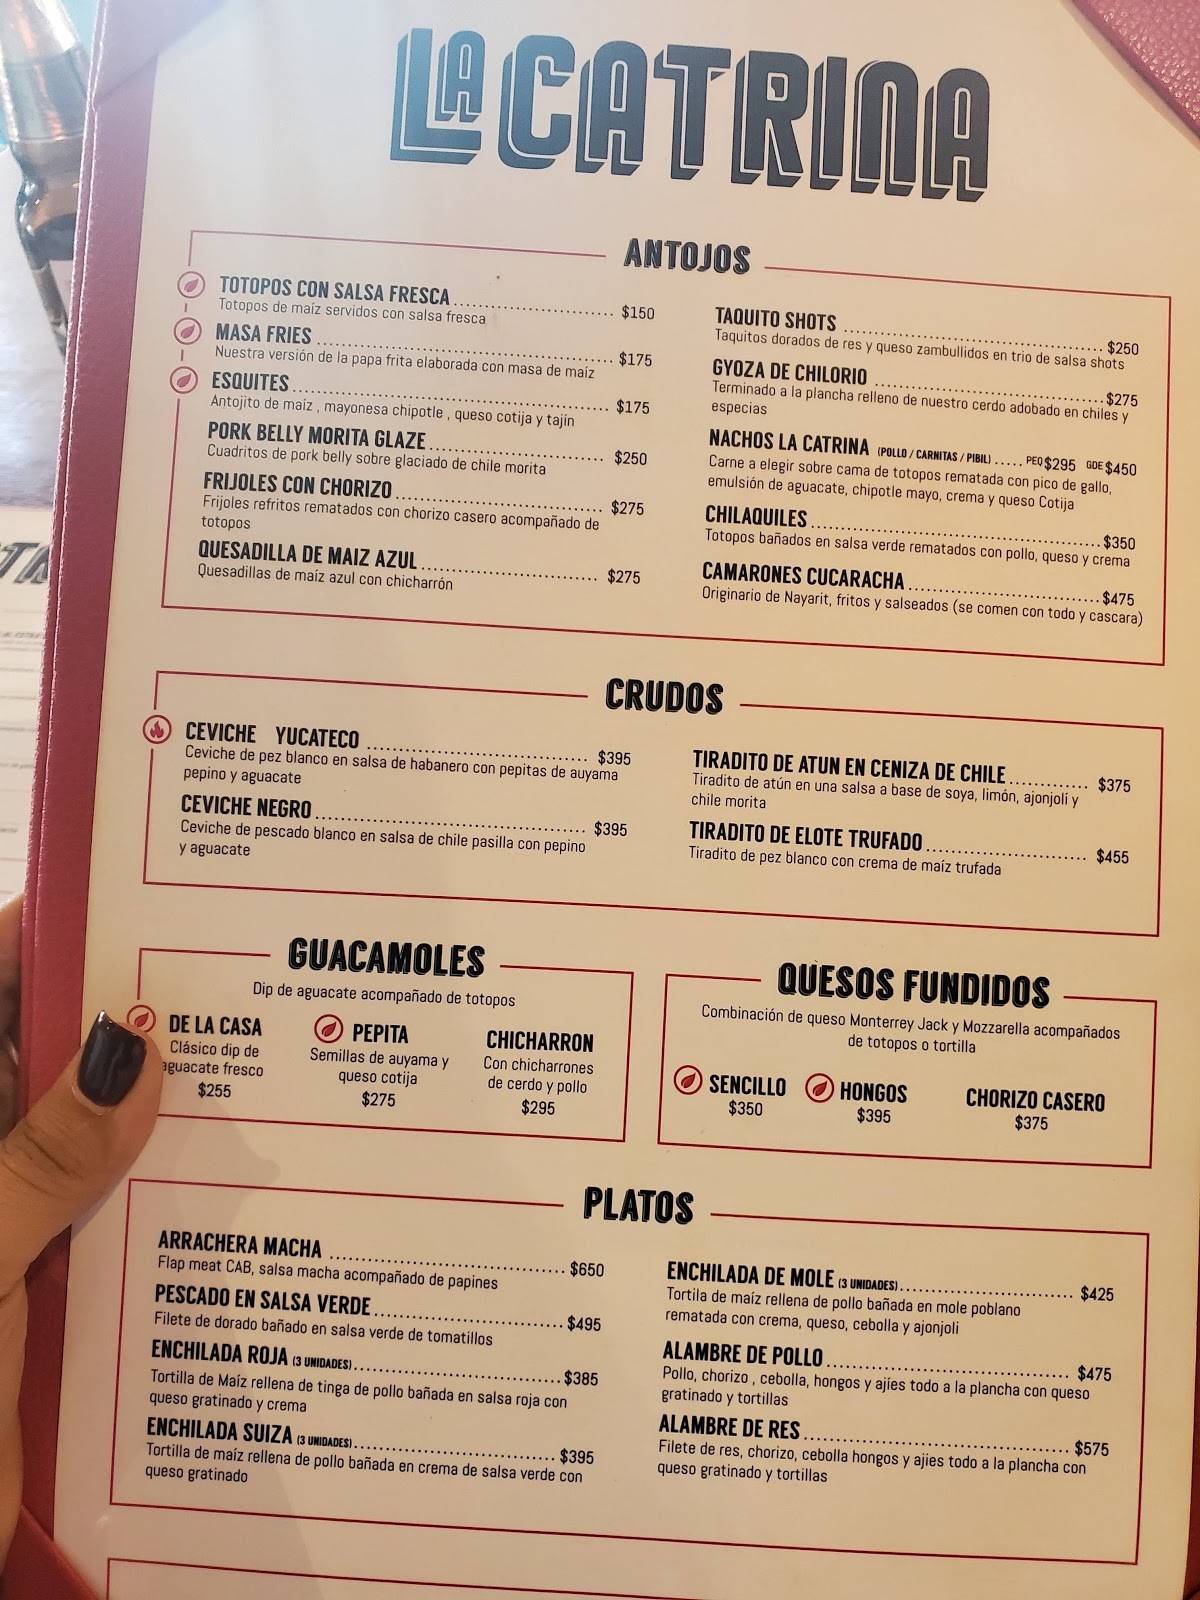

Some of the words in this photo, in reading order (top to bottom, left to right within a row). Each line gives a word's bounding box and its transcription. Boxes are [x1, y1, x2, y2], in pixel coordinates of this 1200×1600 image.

[390, 28, 486, 165] LA
[497, 34, 990, 202] CATRINA
[624, 238, 751, 275] ANTOJOS
[219, 297, 268, 314] Totopos
[273, 300, 287, 313] de
[292, 302, 321, 315] maíz
[325, 305, 378, 318] servidos
[382, 309, 404, 319] con
[409, 309, 442, 322] salsa
[446, 310, 486, 324] fresca
[220, 276, 292, 296] TOTOPOS
[297, 280, 329, 299] CON
[334, 282, 384, 302] SALSA
[389, 285, 450, 306] FRESCA
[622, 304, 655, 320] $150
[715, 306, 780, 328] TAQUITO
[785, 311, 836, 332] SHOTS
[1107, 340, 1139, 356] $250
[212, 371, 289, 392] ESQUITES
[616, 398, 650, 415] $175
[712, 402, 767, 416] especias
[208, 421, 251, 441] PORK
[256, 423, 304, 443] BELLY
[308, 426, 369, 447] MORITA
[374, 430, 426, 450] GLAZE
[614, 450, 647, 466] $250
[709, 428, 774, 450] NACHOS
[779, 433, 798, 451] LA
[803, 434, 870, 456] CATRINA
[877, 446, 907, 458] (POLLO
[916, 449, 958, 462] CARNITAS
[966, 453, 991, 464] PIBIL)
[208, 443, 268, 459] Cuadritos
[272, 447, 287, 460] de
[291, 448, 318, 463] pork
[323, 449, 352, 466] belly
[356, 452, 391, 465] sobre
[395, 454, 448, 469] glaciado
[452, 457, 467, 470] de
[471, 458, 501, 472] chile
[505, 462, 546, 475] morita
[708, 475, 764, 490] emulsión
[768, 477, 783, 491] de
[787, 481, 848, 496] aguacate,
[852, 483, 902, 499] chipotle
[906, 489, 942, 503] mayo,
[946, 492, 984, 503] crema
[988, 495, 995, 507] y
[998, 495, 1035, 508] queso
[1039, 495, 1074, 512] Cotija
[201, 516, 251, 531] totopos
[705, 504, 807, 528] CHILAQUILES
[1103, 534, 1136, 550] $350
[702, 561, 802, 584] CAMARONES
[807, 567, 905, 590] CUCARACHA
[1102, 590, 1134, 606] $475
[605, 678, 724, 715] CRUDOS
[186, 721, 257, 744] CEVICHE
[276, 726, 359, 749] YUCATECO
[598, 749, 631, 766] $395
[184, 768, 226, 782] pepino
[230, 771, 237, 784] y
[241, 771, 301, 785] aguacate
[693, 749, 768, 771] TIRADITO
[773, 754, 794, 773] DE
[798, 755, 840, 775] ATUN
[845, 757, 866, 777] EN
[870, 759, 930, 780] CENIZA
[935, 762, 956, 781] DE
[960, 764, 1006, 784] CHILE
[1098, 776, 1131, 793] $375
[691, 792, 721, 807] chile
[725, 795, 766, 809] morita
[181, 794, 252, 816] CEVICHE
[257, 798, 312, 819] NEGRO
[594, 820, 627, 837] $395
[689, 845, 737, 861] Tiradito
[741, 848, 756, 862] de
[759, 852, 782, 866] pez
[786, 850, 827, 866] blanco
[831, 856, 854, 867] con
[858, 858, 898, 870] crema
[902, 857, 917, 871] de
[921, 859, 951, 873] maíz
[955, 861, 1001, 876] trufada
[288, 937, 485, 978] GUACAMOLES
[778, 962, 894, 1001] QUESOS
[903, 969, 1050, 1009] FUNDIDOS
[169, 1014, 190, 1033] DE
[195, 1015, 215, 1035] LA
[219, 1016, 262, 1036] CASA
[353, 1023, 409, 1044] PEPITA
[170, 1040, 217, 1055] Clásico
[221, 1043, 240, 1060] dip
[244, 1044, 259, 1058] de
[487, 1030, 594, 1053] CHICHARRON
[848, 1034, 863, 1048] de
[867, 1035, 917, 1053] totopos
[921, 1041, 929, 1051] o
[933, 1039, 976, 1053] tortilla
[223, 1062, 263, 1077] fresco
[338, 1071, 377, 1084] queso
[381, 1071, 417, 1088] cotija
[484, 1055, 508, 1070] Con
[511, 1058, 594, 1075] chicharrones
[198, 1081, 231, 1098] $255
[361, 1090, 396, 1108] $275
[488, 1075, 503, 1089] de
[507, 1077, 543, 1091] cerdo
[546, 1081, 554, 1095] y
[557, 1079, 587, 1095] pollo
[709, 1074, 786, 1097] SENCILLO
[840, 1081, 908, 1104] HONGOS
[521, 1098, 555, 1116] $295
[728, 1099, 763, 1117] $350
[966, 1088, 1038, 1110] CHORIZO
[1043, 1091, 1105, 1112] CASERO
[857, 1106, 891, 1124] $395
[1015, 1114, 1048, 1131] $375
[583, 1187, 695, 1225] PLATOS
[158, 1230, 258, 1255] ARRACHERA
[263, 1236, 322, 1259] MACHA
[570, 1260, 604, 1278] $650
[667, 1261, 759, 1285] ENCHILADA
[764, 1266, 786, 1286] DE
[790, 1268, 835, 1288] MOLE
[1080, 1285, 1114, 1302] $425
[154, 1311, 191, 1326] Filete
[195, 1314, 210, 1328] de
[214, 1315, 257, 1331] dorado
[261, 1318, 307, 1334] bañado
[311, 1324, 327, 1335] en
[331, 1323, 365, 1338] salsa
[369, 1326, 404, 1340] verde
[408, 1328, 423, 1342] de
[427, 1330, 493, 1346] tomatillos
[151, 1339, 242, 1363] ENCHILADA
[248, 1345, 288, 1366] ROJA
[292, 1355, 302, 1367] (3
[304, 1357, 352, 1371] UNIDADES)
[564, 1369, 598, 1387] $385
[662, 1340, 742, 1363] ALAMBRE
[746, 1345, 768, 1365] DE
[772, 1346, 823, 1367] POLLO
[1077, 1364, 1112, 1382] $475
[662, 1388, 722, 1403] gratinado
[726, 1393, 734, 1407] y
[737, 1392, 788, 1406] tortillas
